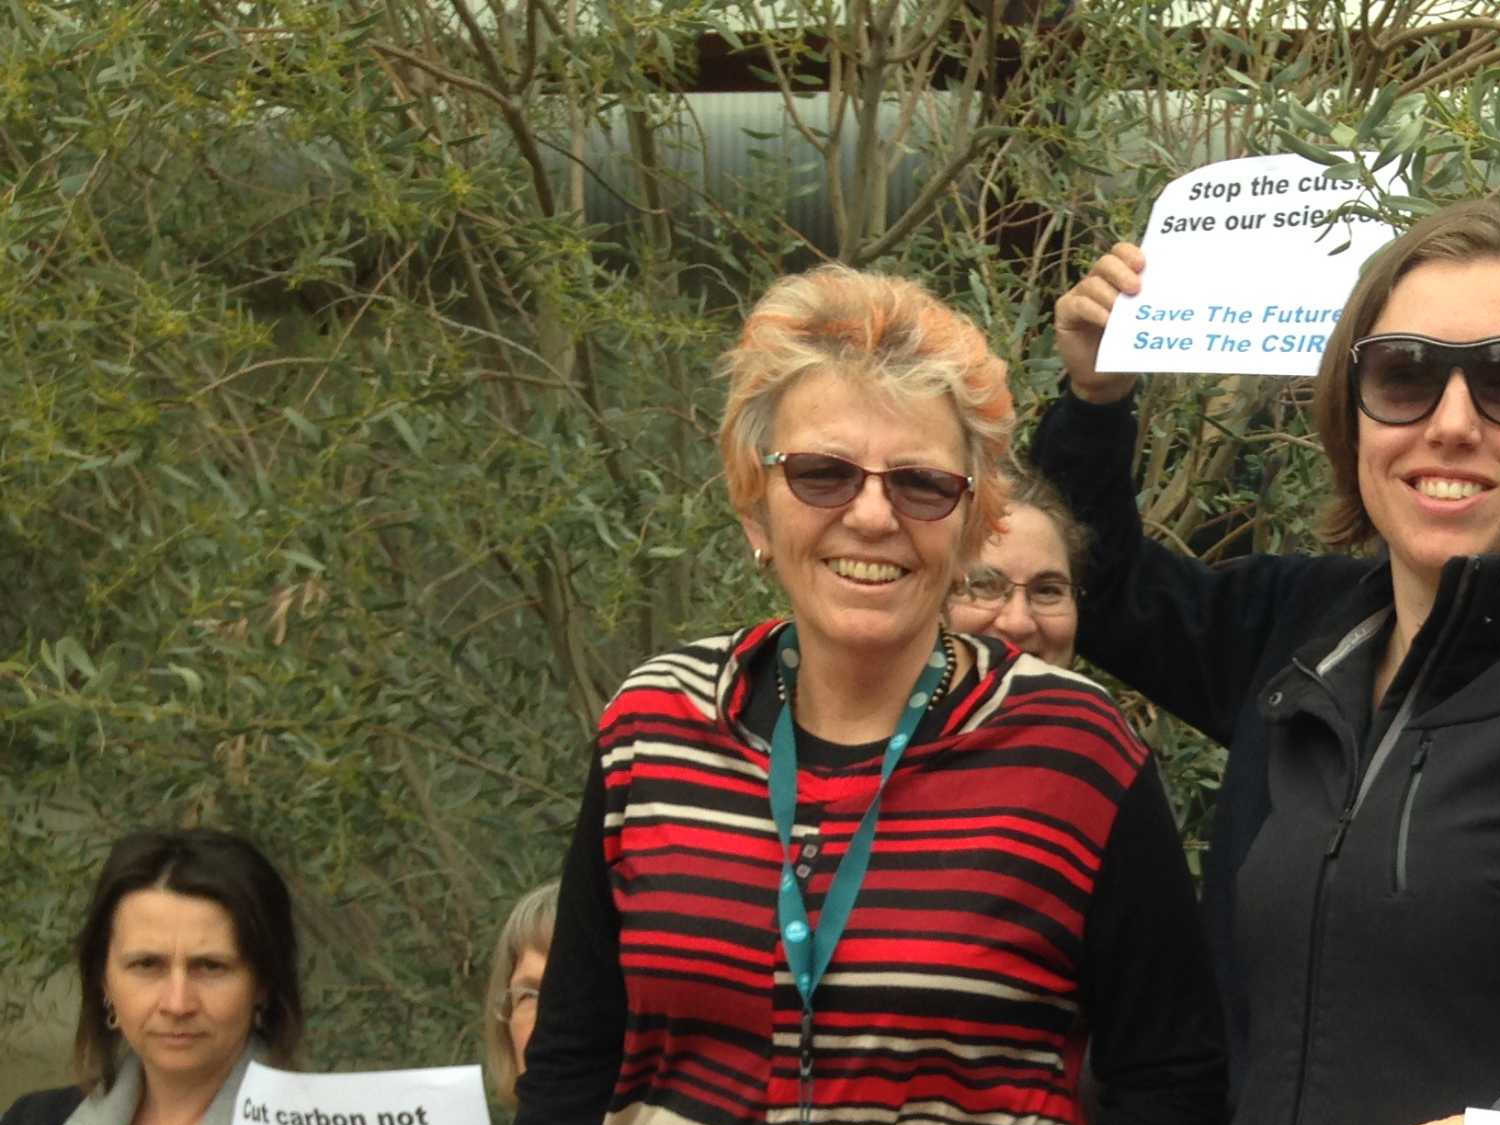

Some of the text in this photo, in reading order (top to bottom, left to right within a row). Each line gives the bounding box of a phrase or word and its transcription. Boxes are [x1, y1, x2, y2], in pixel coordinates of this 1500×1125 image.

[1188, 176, 1241, 202] Stop
[1250, 175, 1290, 197] the
[1160, 215, 1216, 235] Save
[1224, 213, 1267, 231] our
[1135, 304, 1343, 324] Save The Future
[1133, 331, 1326, 353] Save The CSIR
[243, 1097, 270, 1125] Cut
